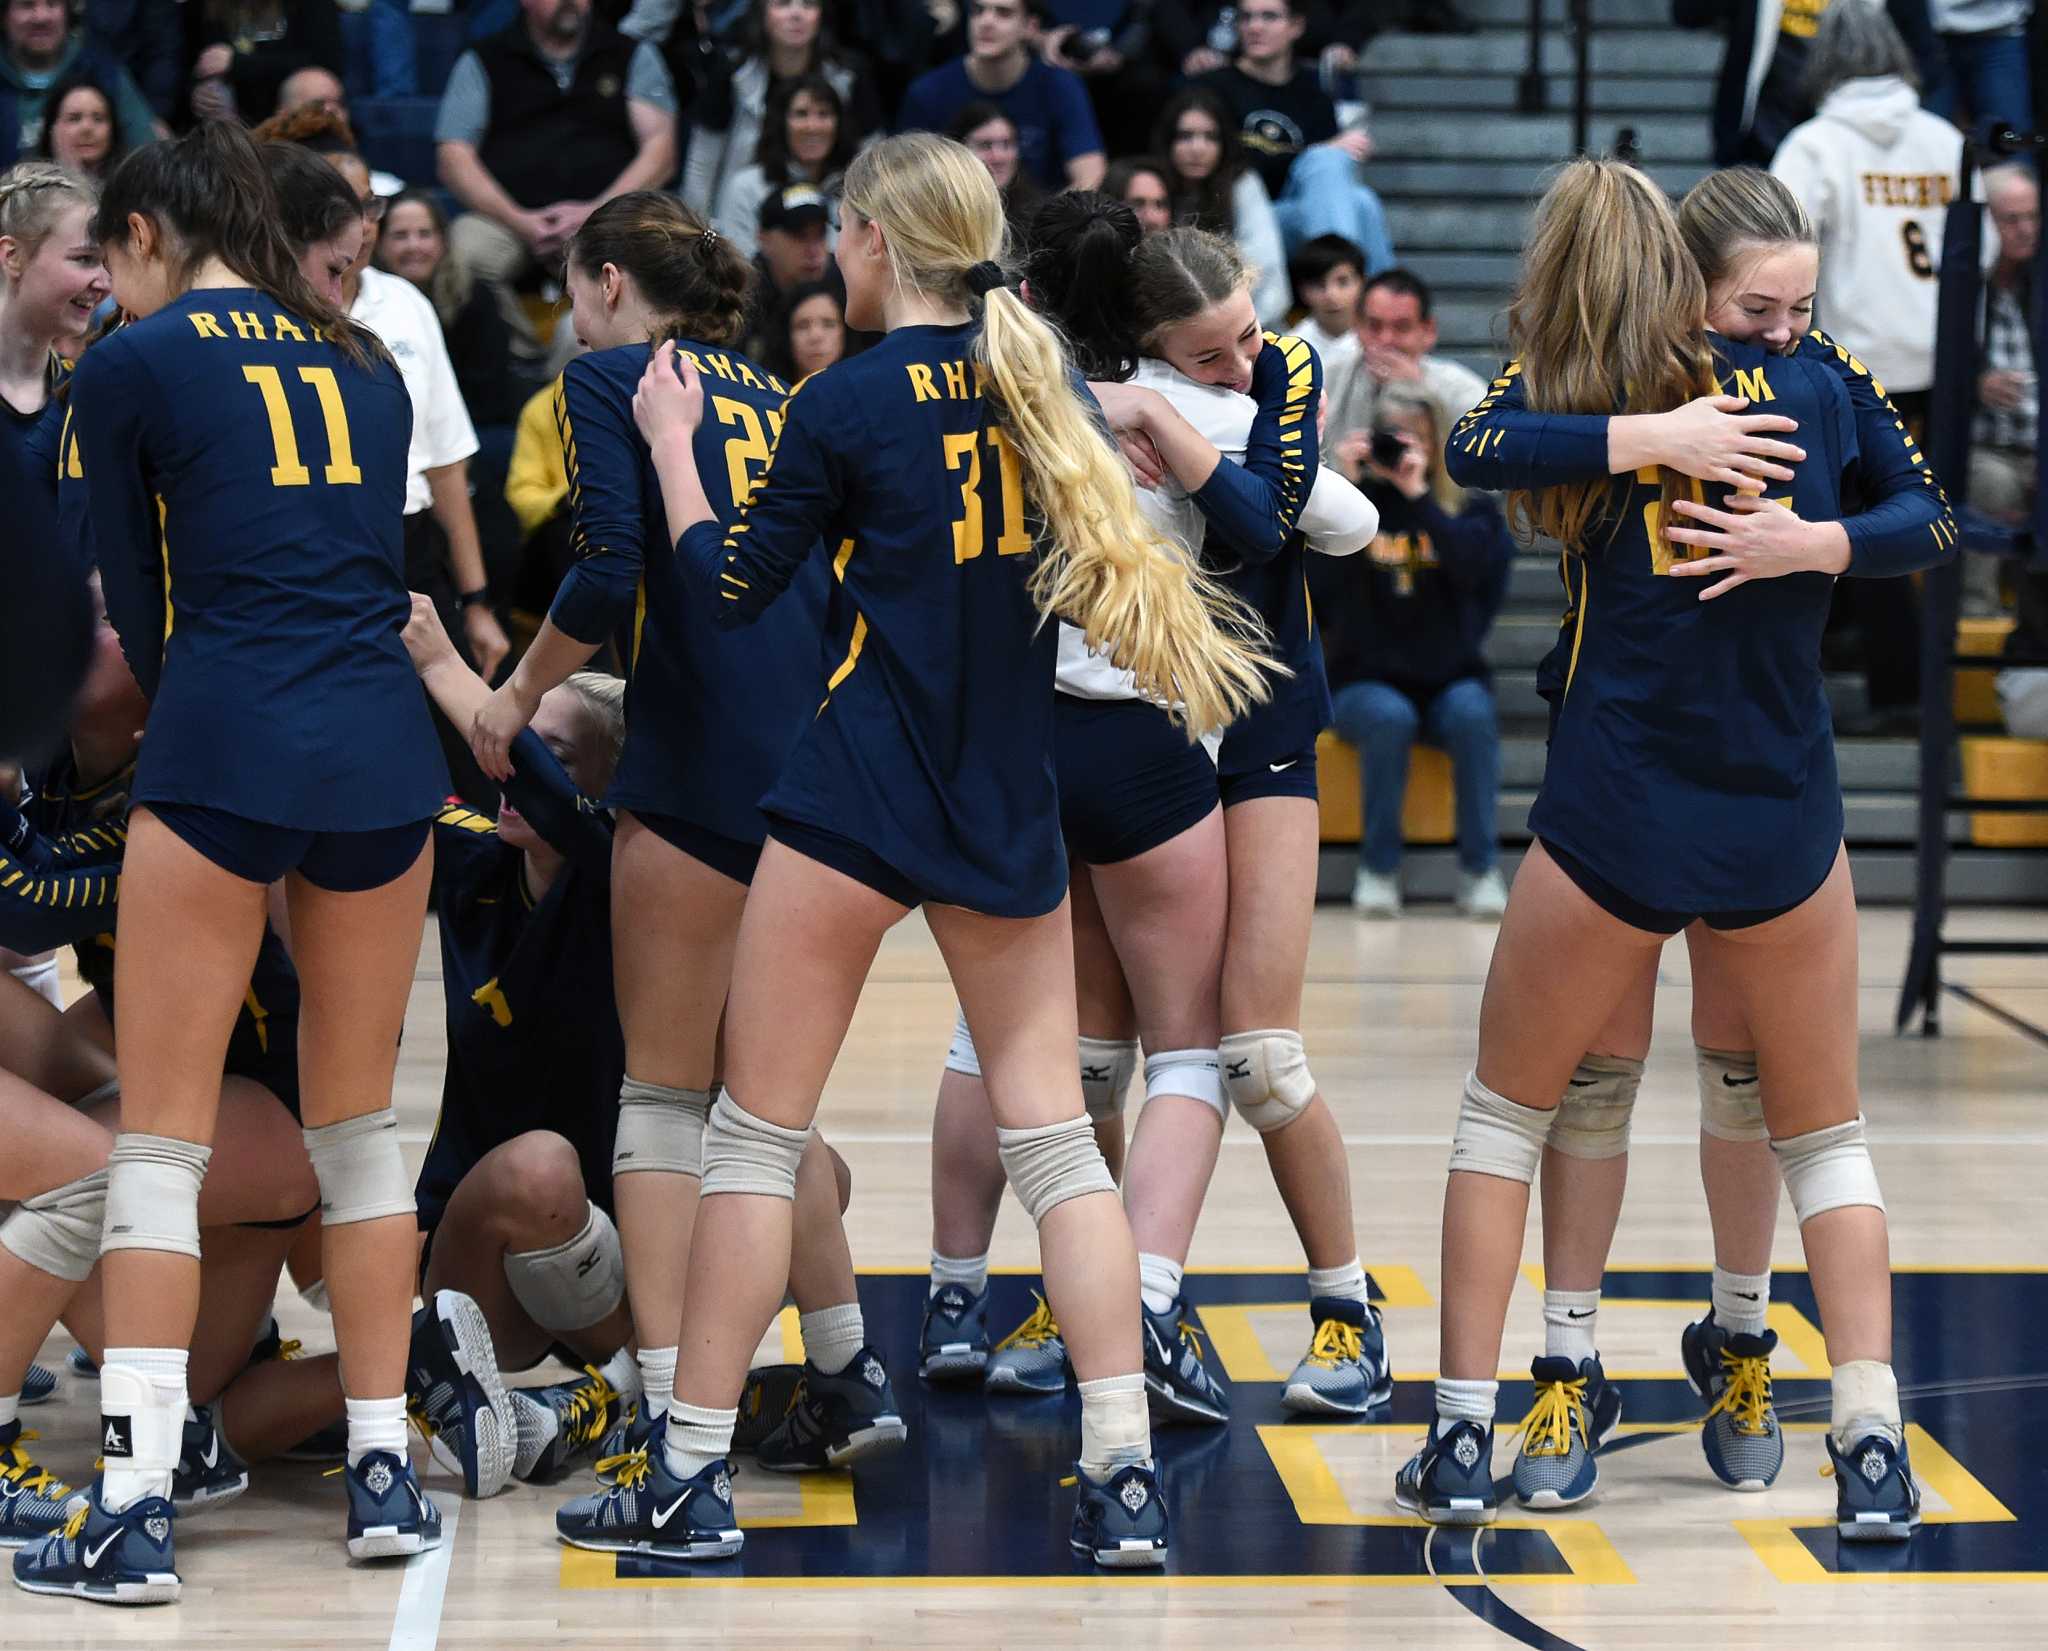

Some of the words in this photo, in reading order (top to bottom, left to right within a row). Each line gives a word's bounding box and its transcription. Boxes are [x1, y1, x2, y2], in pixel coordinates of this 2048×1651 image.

[242, 365, 362, 486] 11
[711, 395, 781, 508] 2
[943, 426, 1032, 565] 31
